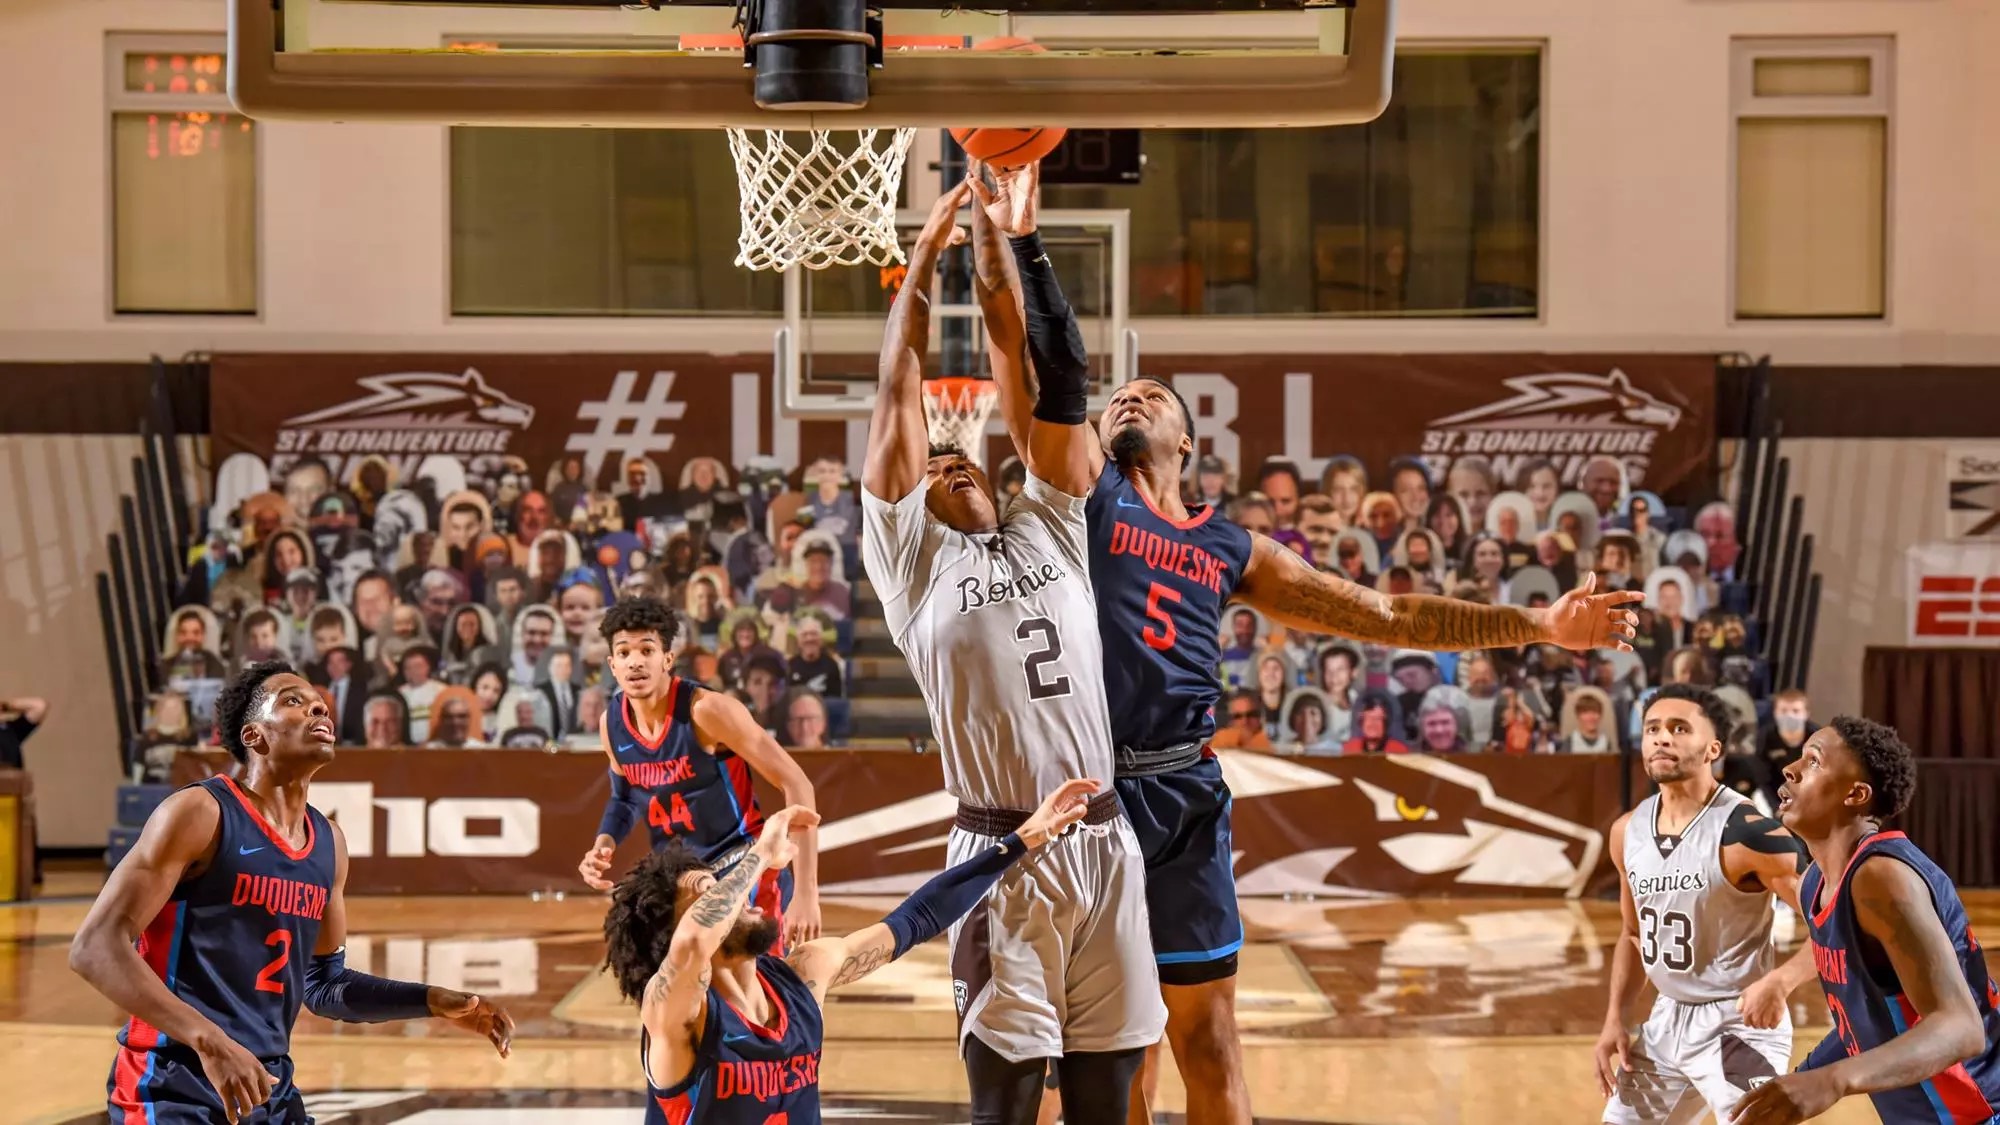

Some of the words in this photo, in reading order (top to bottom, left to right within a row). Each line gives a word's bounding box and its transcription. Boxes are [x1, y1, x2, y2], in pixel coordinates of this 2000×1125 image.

[1142, 581, 1182, 651] 5
[1015, 615, 1073, 702] 2
[648, 792, 696, 835] 44
[254, 928, 292, 994] 2
[1639, 905, 1694, 973] 33
